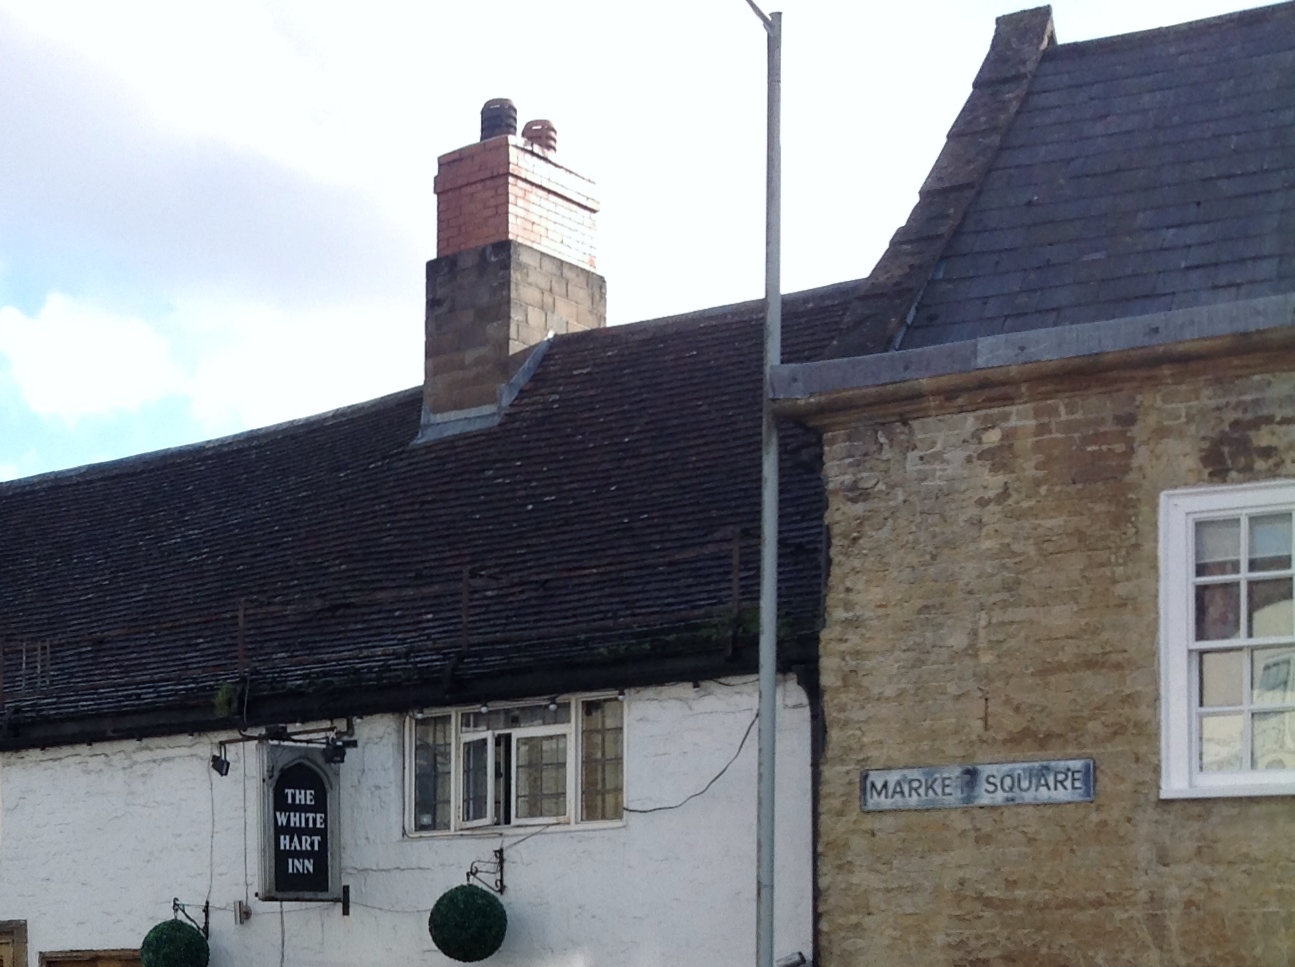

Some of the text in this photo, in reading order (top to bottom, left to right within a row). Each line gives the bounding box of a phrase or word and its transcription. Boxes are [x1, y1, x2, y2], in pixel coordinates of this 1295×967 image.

[984, 769, 1083, 795] SQUARE
[285, 788, 315, 805] THE
[275, 811, 325, 828] WHITE
[279, 833, 321, 851] HART
[288, 858, 314, 874] INN
